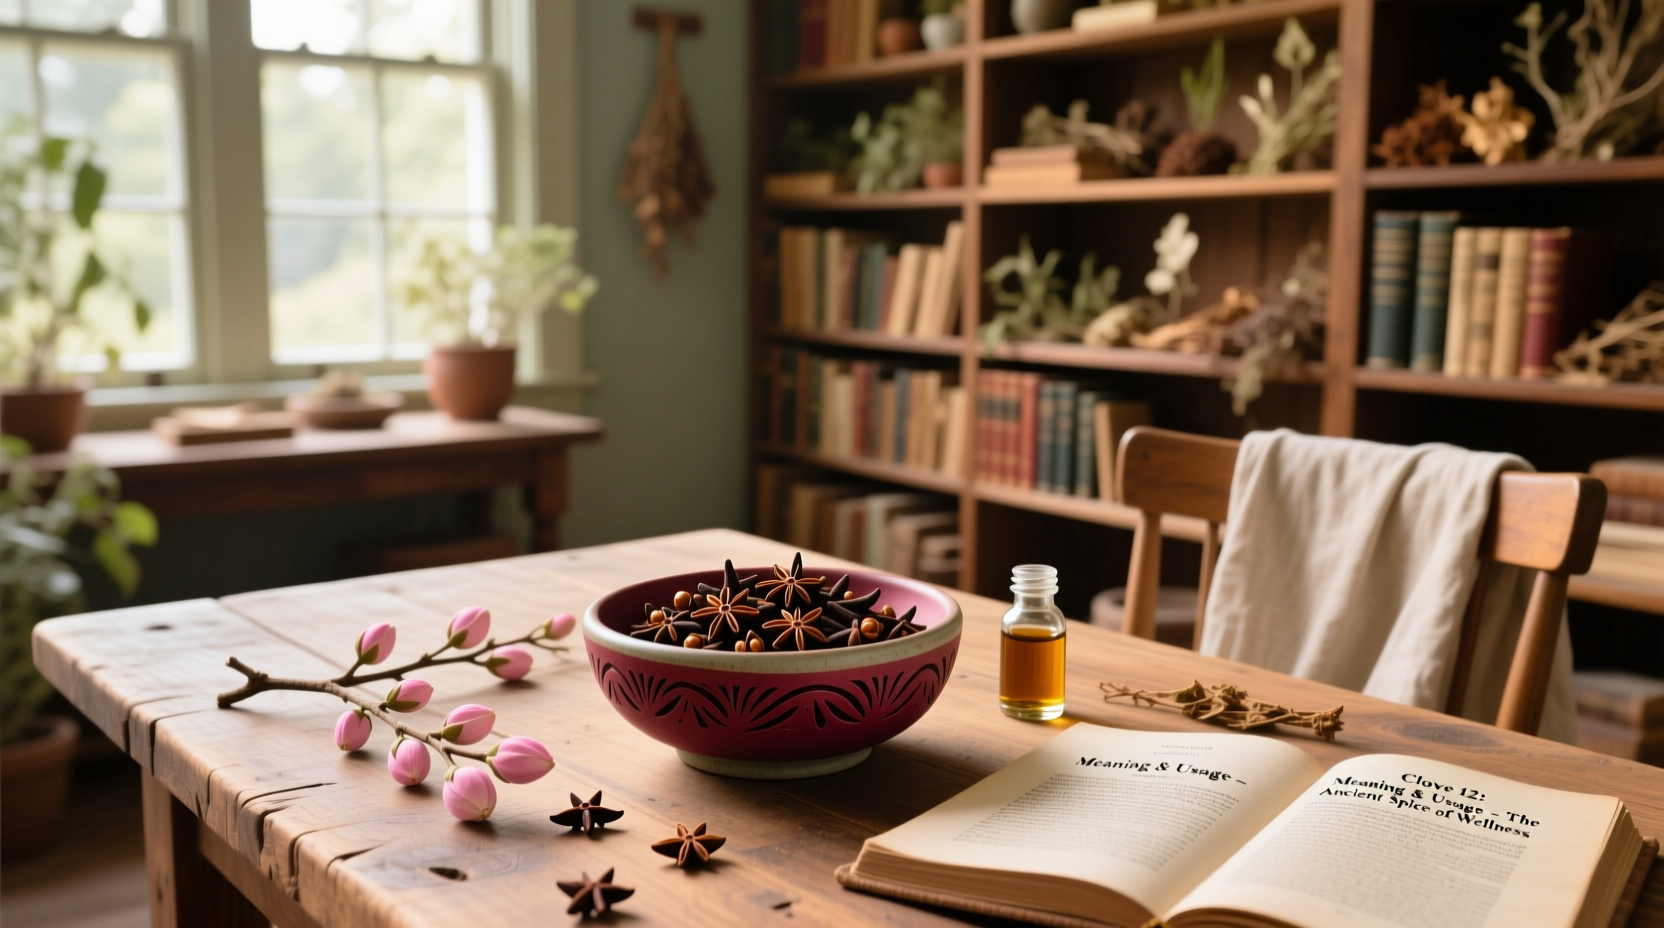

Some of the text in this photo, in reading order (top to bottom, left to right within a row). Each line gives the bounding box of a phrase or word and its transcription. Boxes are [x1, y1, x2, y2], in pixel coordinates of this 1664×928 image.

[1075, 756, 1151, 772] Meaning
[1154, 761, 1170, 771] &
[1401, 773, 1486, 801] Clove 12:
[1411, 789, 1424, 799] &
[1507, 811, 1540, 827] The
[1435, 808, 1454, 819] of
[1457, 812, 1530, 838] Wellness
